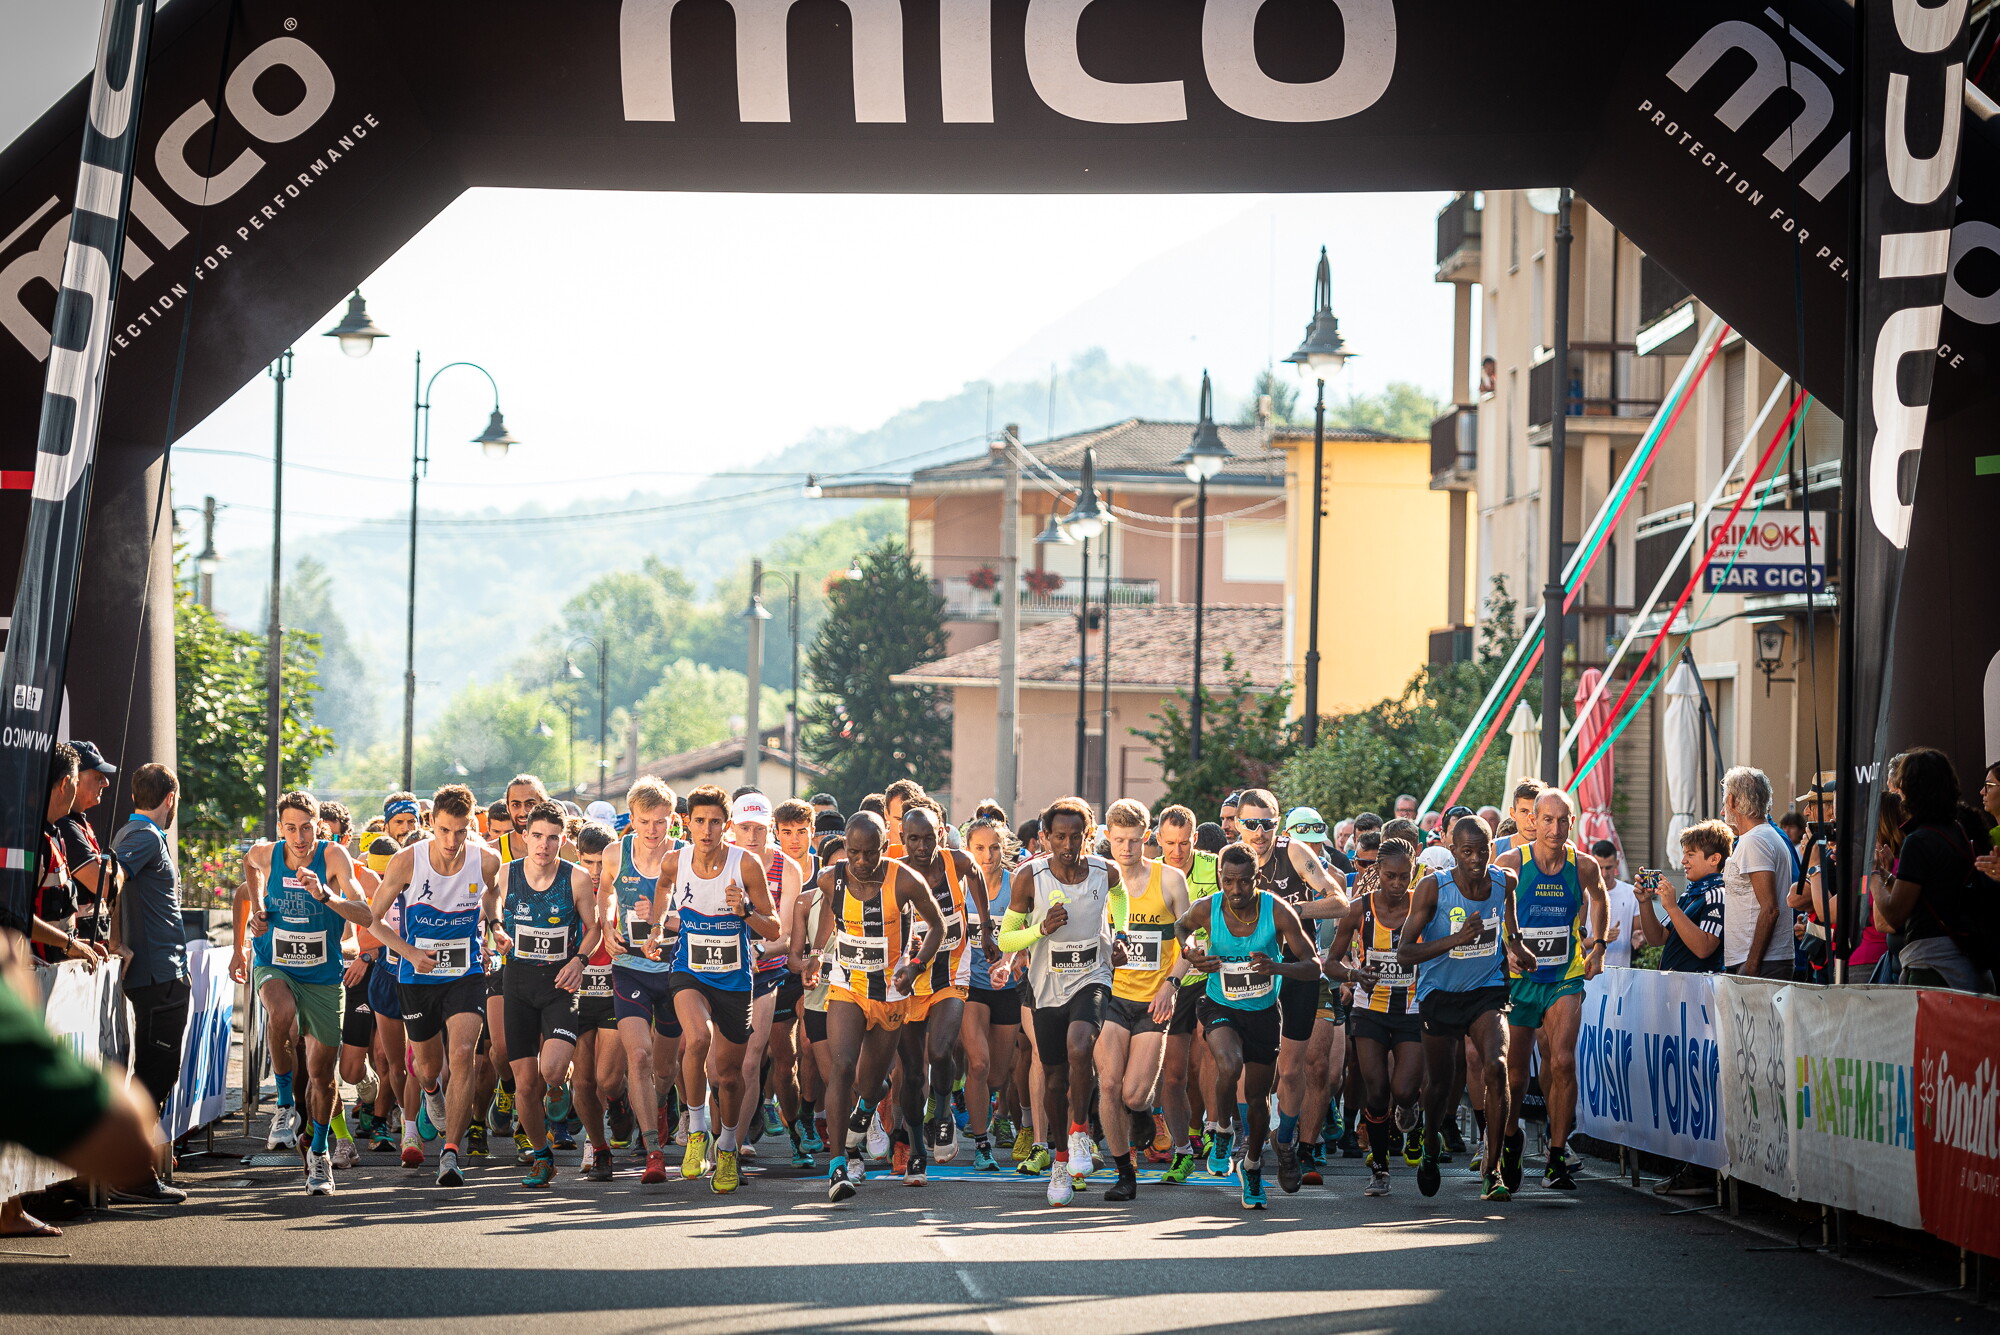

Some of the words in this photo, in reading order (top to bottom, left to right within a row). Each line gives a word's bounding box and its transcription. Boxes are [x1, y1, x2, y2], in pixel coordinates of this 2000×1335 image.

[620, 0, 1397, 124] mico
[1638, 99, 1764, 206] PROTECTION
[1770, 207, 1810, 245] FOR
[194, 244, 232, 281] FOR
[236, 113, 380, 241] PERFORMANCE
[1711, 567, 1758, 587] BAR
[1764, 567, 1821, 587] CICO
[284, 891, 303, 900] THE
[272, 897, 303, 908] NORTH
[1149, 914, 1161, 923] AC
[683, 920, 741, 930] VALCHIESE
[290, 942, 308, 954] 13
[534, 938, 551, 949] 10
[1127, 943, 1144, 956] 20
[1537, 938, 1555, 951] 97
[282, 952, 317, 960] AYMONOD
[436, 950, 450, 962] 15
[706, 947, 723, 959] 14
[856, 947, 864, 959] 5
[1071, 952, 1080, 963] 8
[1379, 962, 1403, 974] 201
[591, 975, 607, 986] 12
[1244, 974, 1251, 986] 1
[1644, 1002, 1720, 1140] valsir
[1934, 1050, 2000, 1160] fondit
